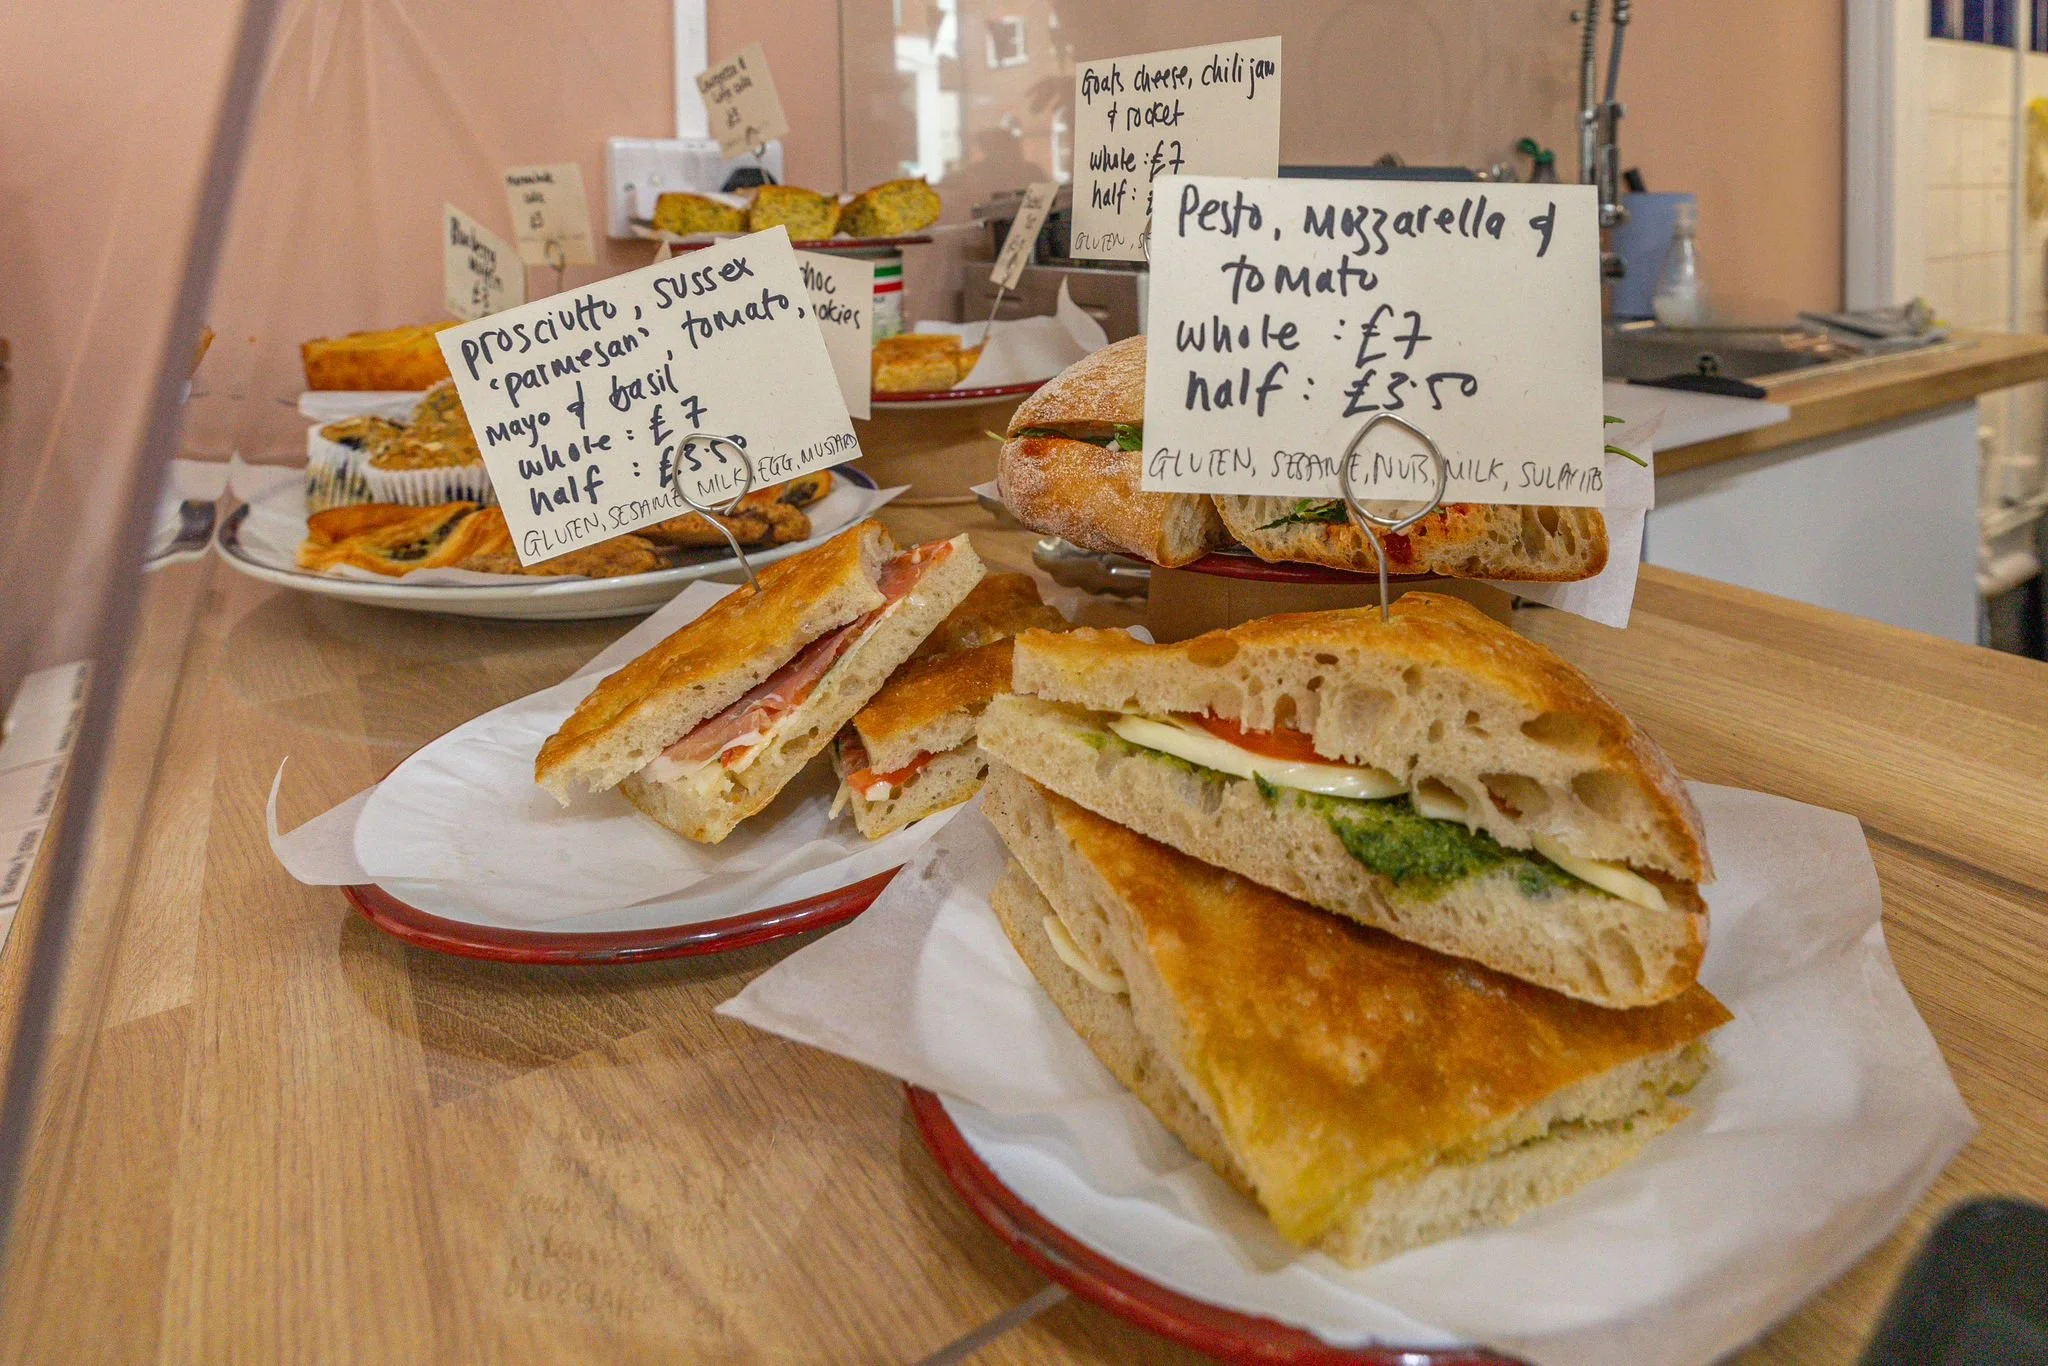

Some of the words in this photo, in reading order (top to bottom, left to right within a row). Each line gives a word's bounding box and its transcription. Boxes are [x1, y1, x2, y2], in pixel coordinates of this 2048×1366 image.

[1127, 99, 1184, 131] rocket
[1179, 184, 1281, 242] Pesto,
[1149, 448, 1256, 480] GLUTEN,
